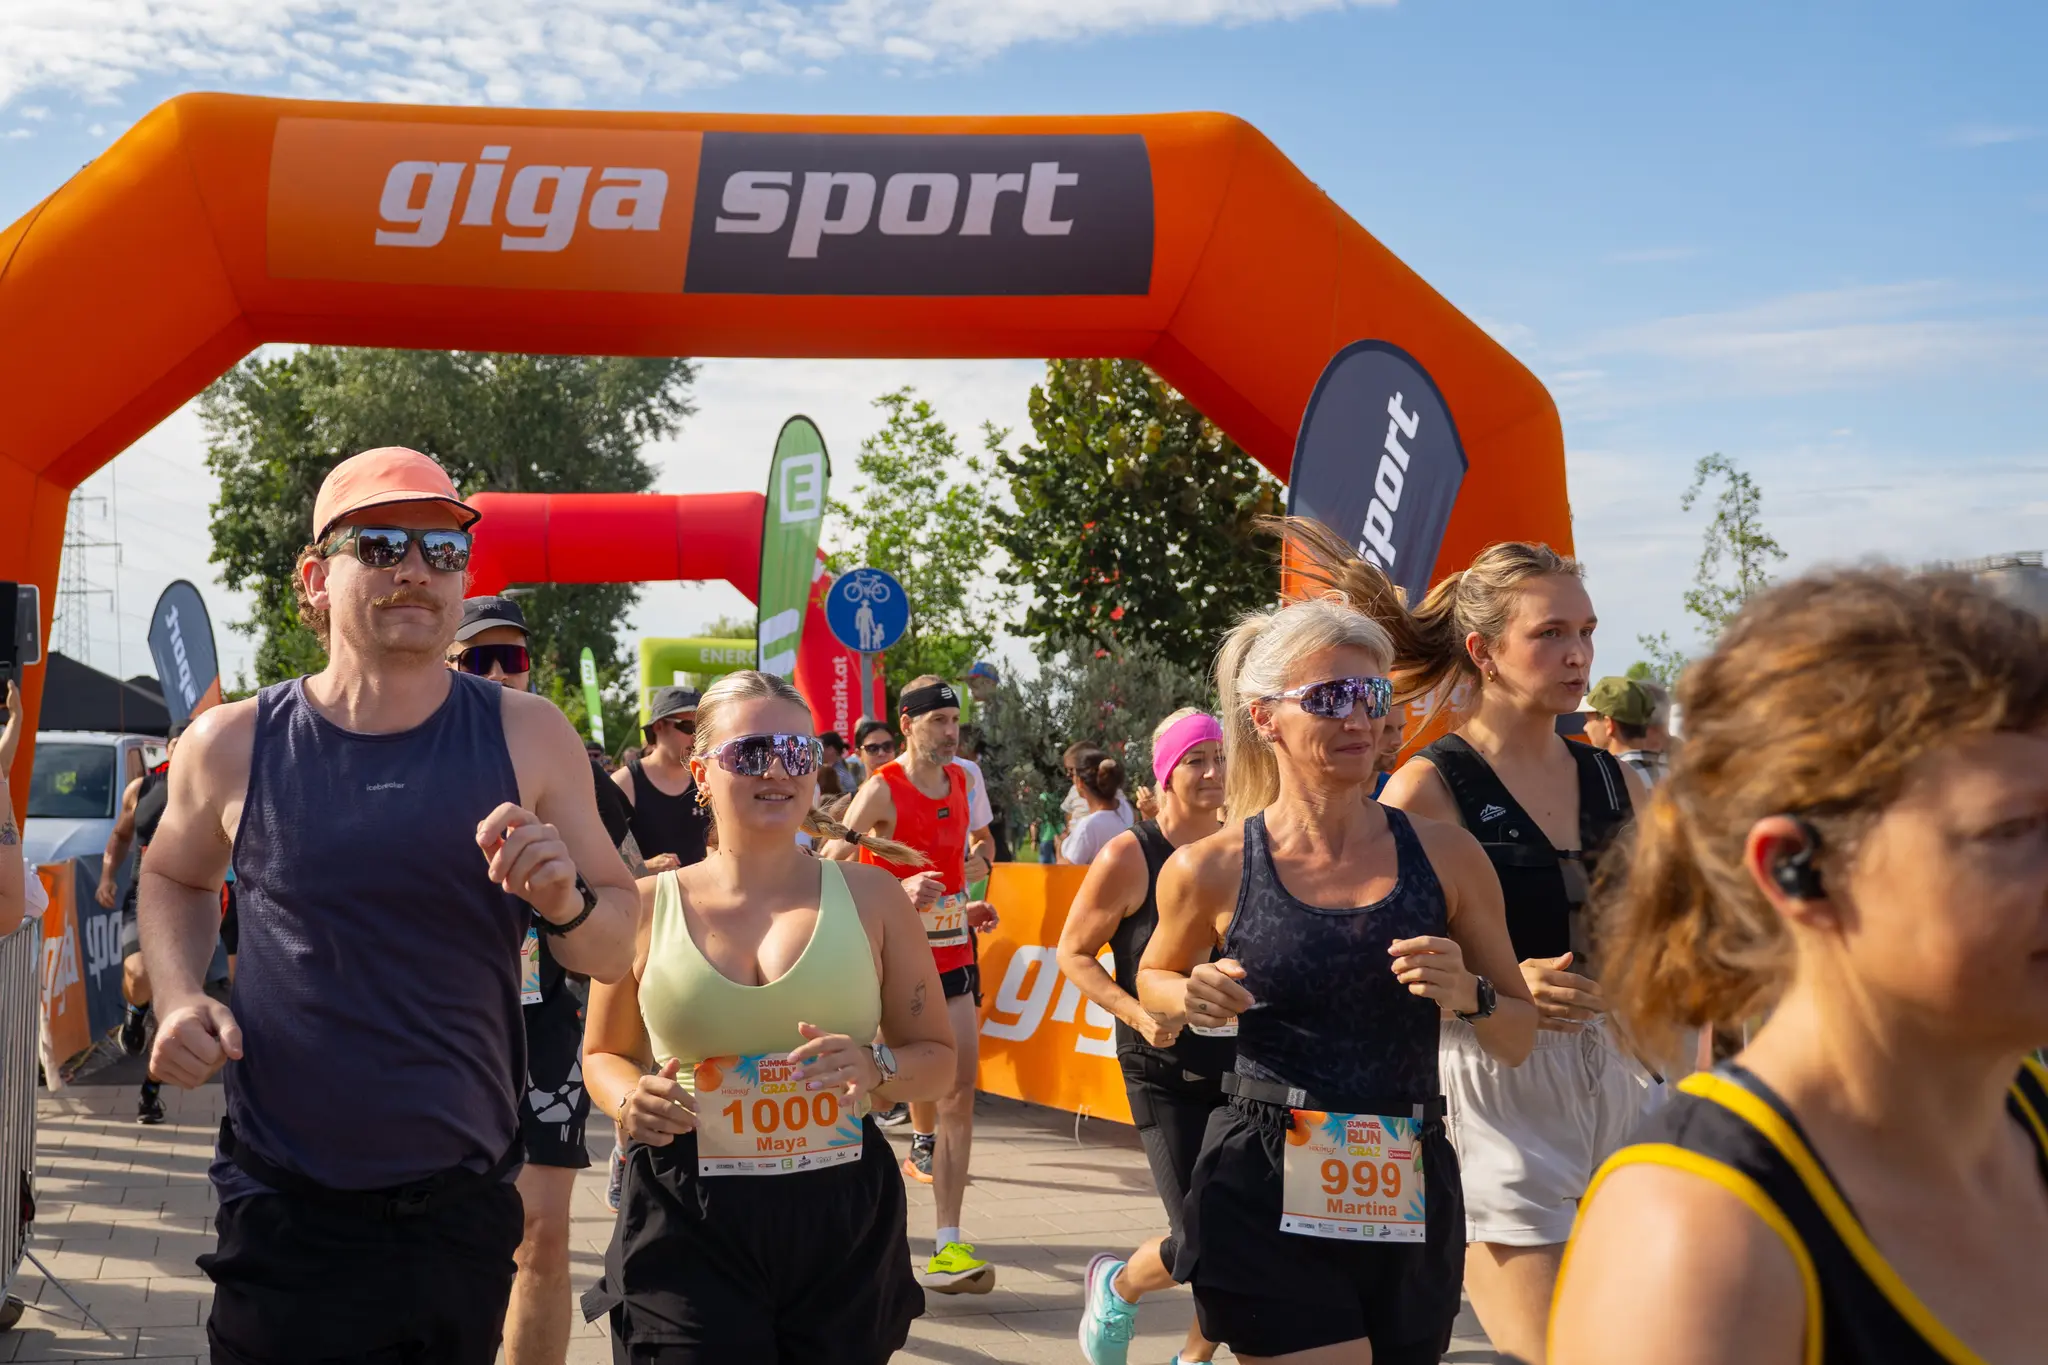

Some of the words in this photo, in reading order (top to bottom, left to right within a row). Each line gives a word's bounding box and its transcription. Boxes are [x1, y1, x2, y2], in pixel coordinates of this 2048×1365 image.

[375, 145, 669, 252] giga
[714, 161, 1080, 259] sport
[935, 912, 962, 930] 717
[761, 1083, 797, 1094] GRAZ
[722, 1092, 839, 1134] 1000
[1347, 1121, 1380, 1129] SUMMER
[756, 1136, 807, 1152] Maya
[1347, 1129, 1381, 1144] RUN
[1347, 1146, 1381, 1156] GRAZ
[1321, 1159, 1401, 1198] 999
[1326, 1198, 1397, 1217] Martina
